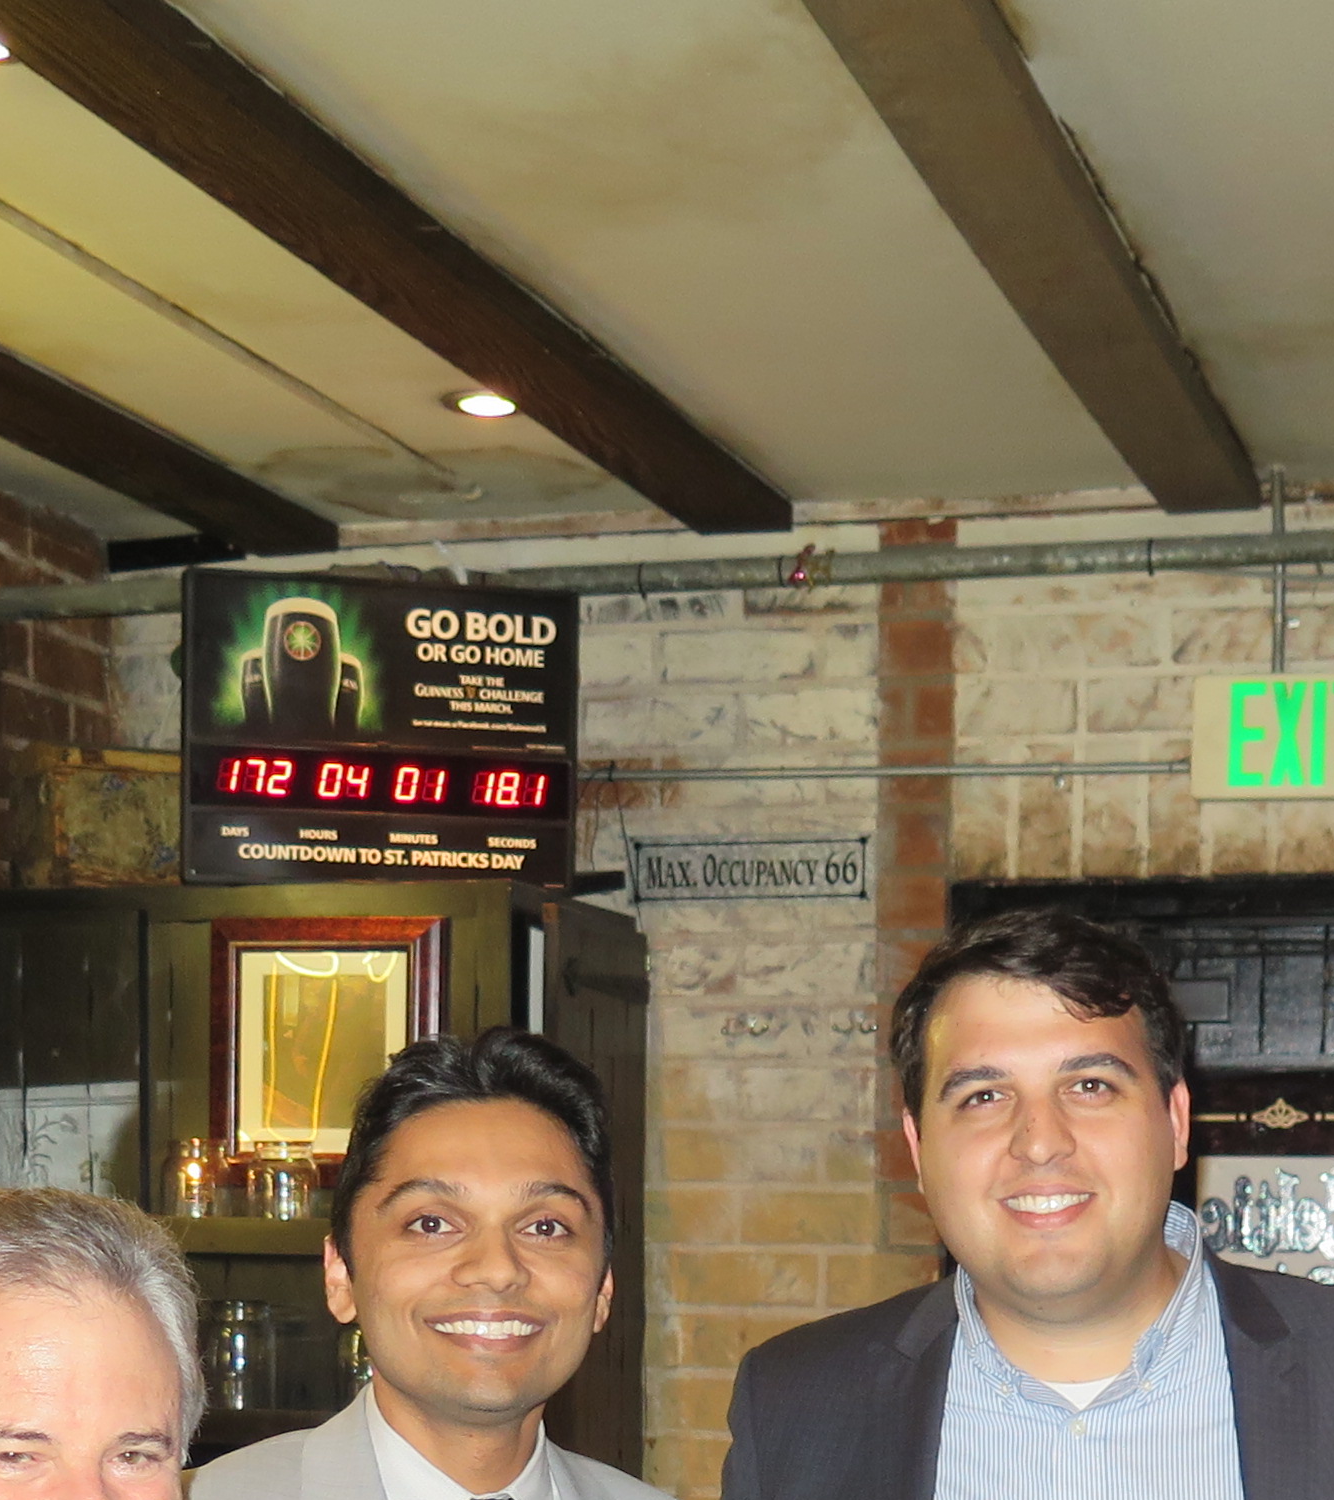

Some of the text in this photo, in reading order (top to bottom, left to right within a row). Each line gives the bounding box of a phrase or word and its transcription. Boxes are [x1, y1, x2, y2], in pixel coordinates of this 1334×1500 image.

[405, 608, 557, 646] GO BOLD
[417, 642, 546, 668] OR GO HOME
[414, 683, 545, 704] GUINNESS CHALLENGE
[459, 674, 505, 688] TAKE THE
[449, 700, 473, 712] THIS
[229, 759, 294, 797] 172
[317, 763, 370, 798] 04
[394, 766, 446, 801] 01
[221, 825, 537, 850] DAYS HOURS MINUTES SECONDS
[238, 843, 525, 870] COUNTDOWN TO ST. PATRICKS DAY
[825, 850, 858, 886] 66
